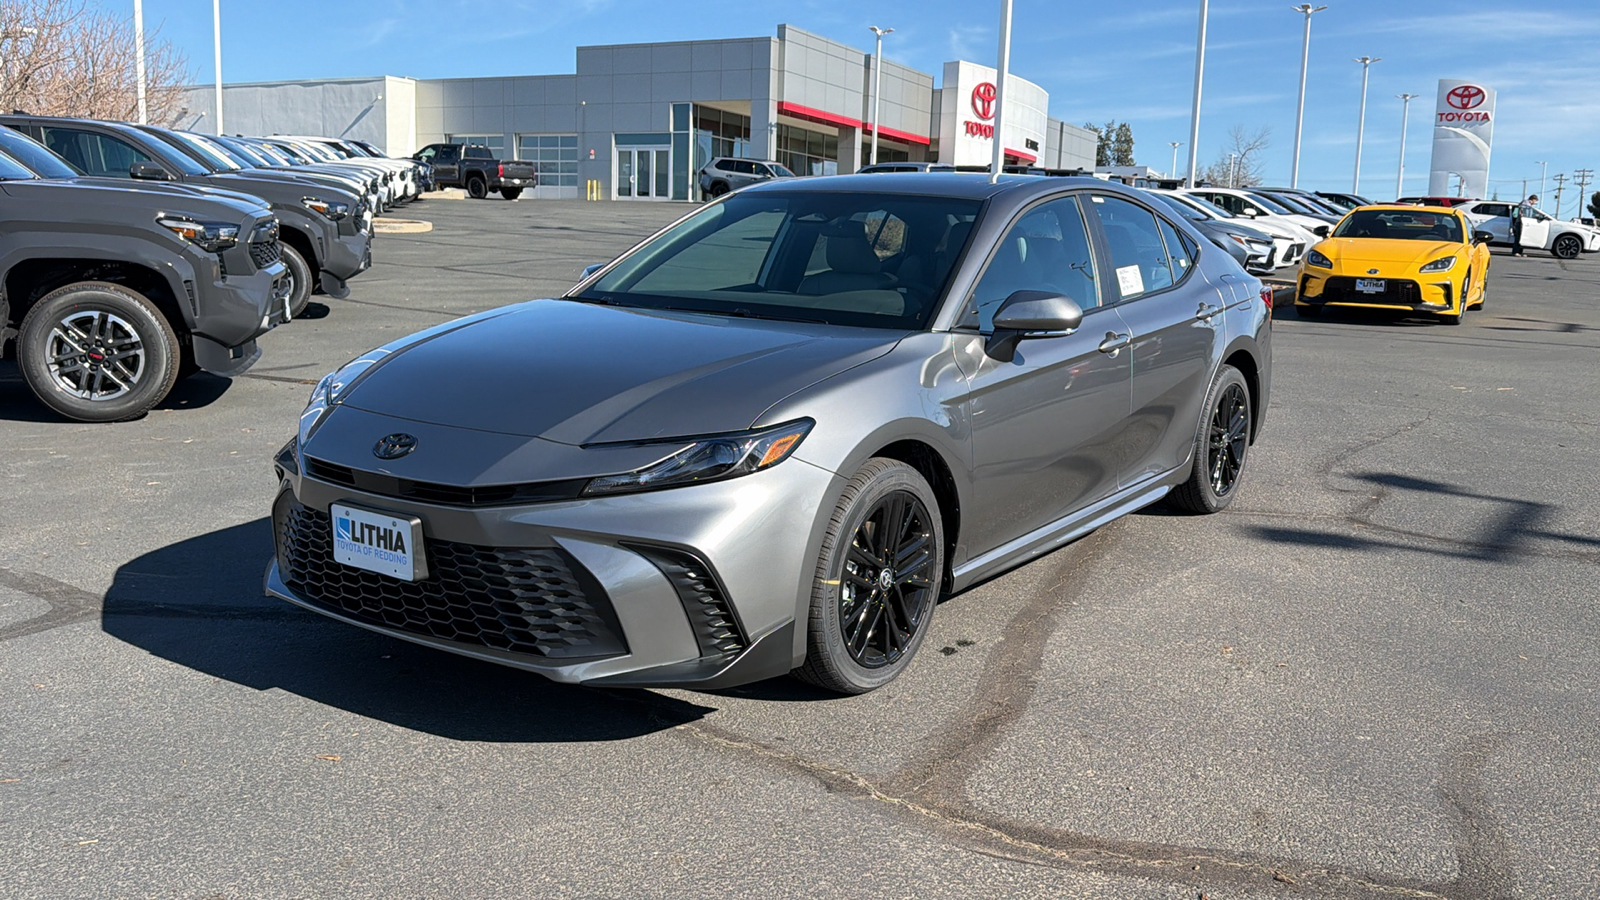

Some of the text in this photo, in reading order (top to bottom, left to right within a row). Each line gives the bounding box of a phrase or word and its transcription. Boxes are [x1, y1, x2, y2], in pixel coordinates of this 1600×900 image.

[1437, 112, 1490, 122] TOYOTA
[963, 121, 994, 138] TOYO
[351, 520, 407, 555] LITHIA
[337, 540, 408, 566] TOYOTA OF REDDING
